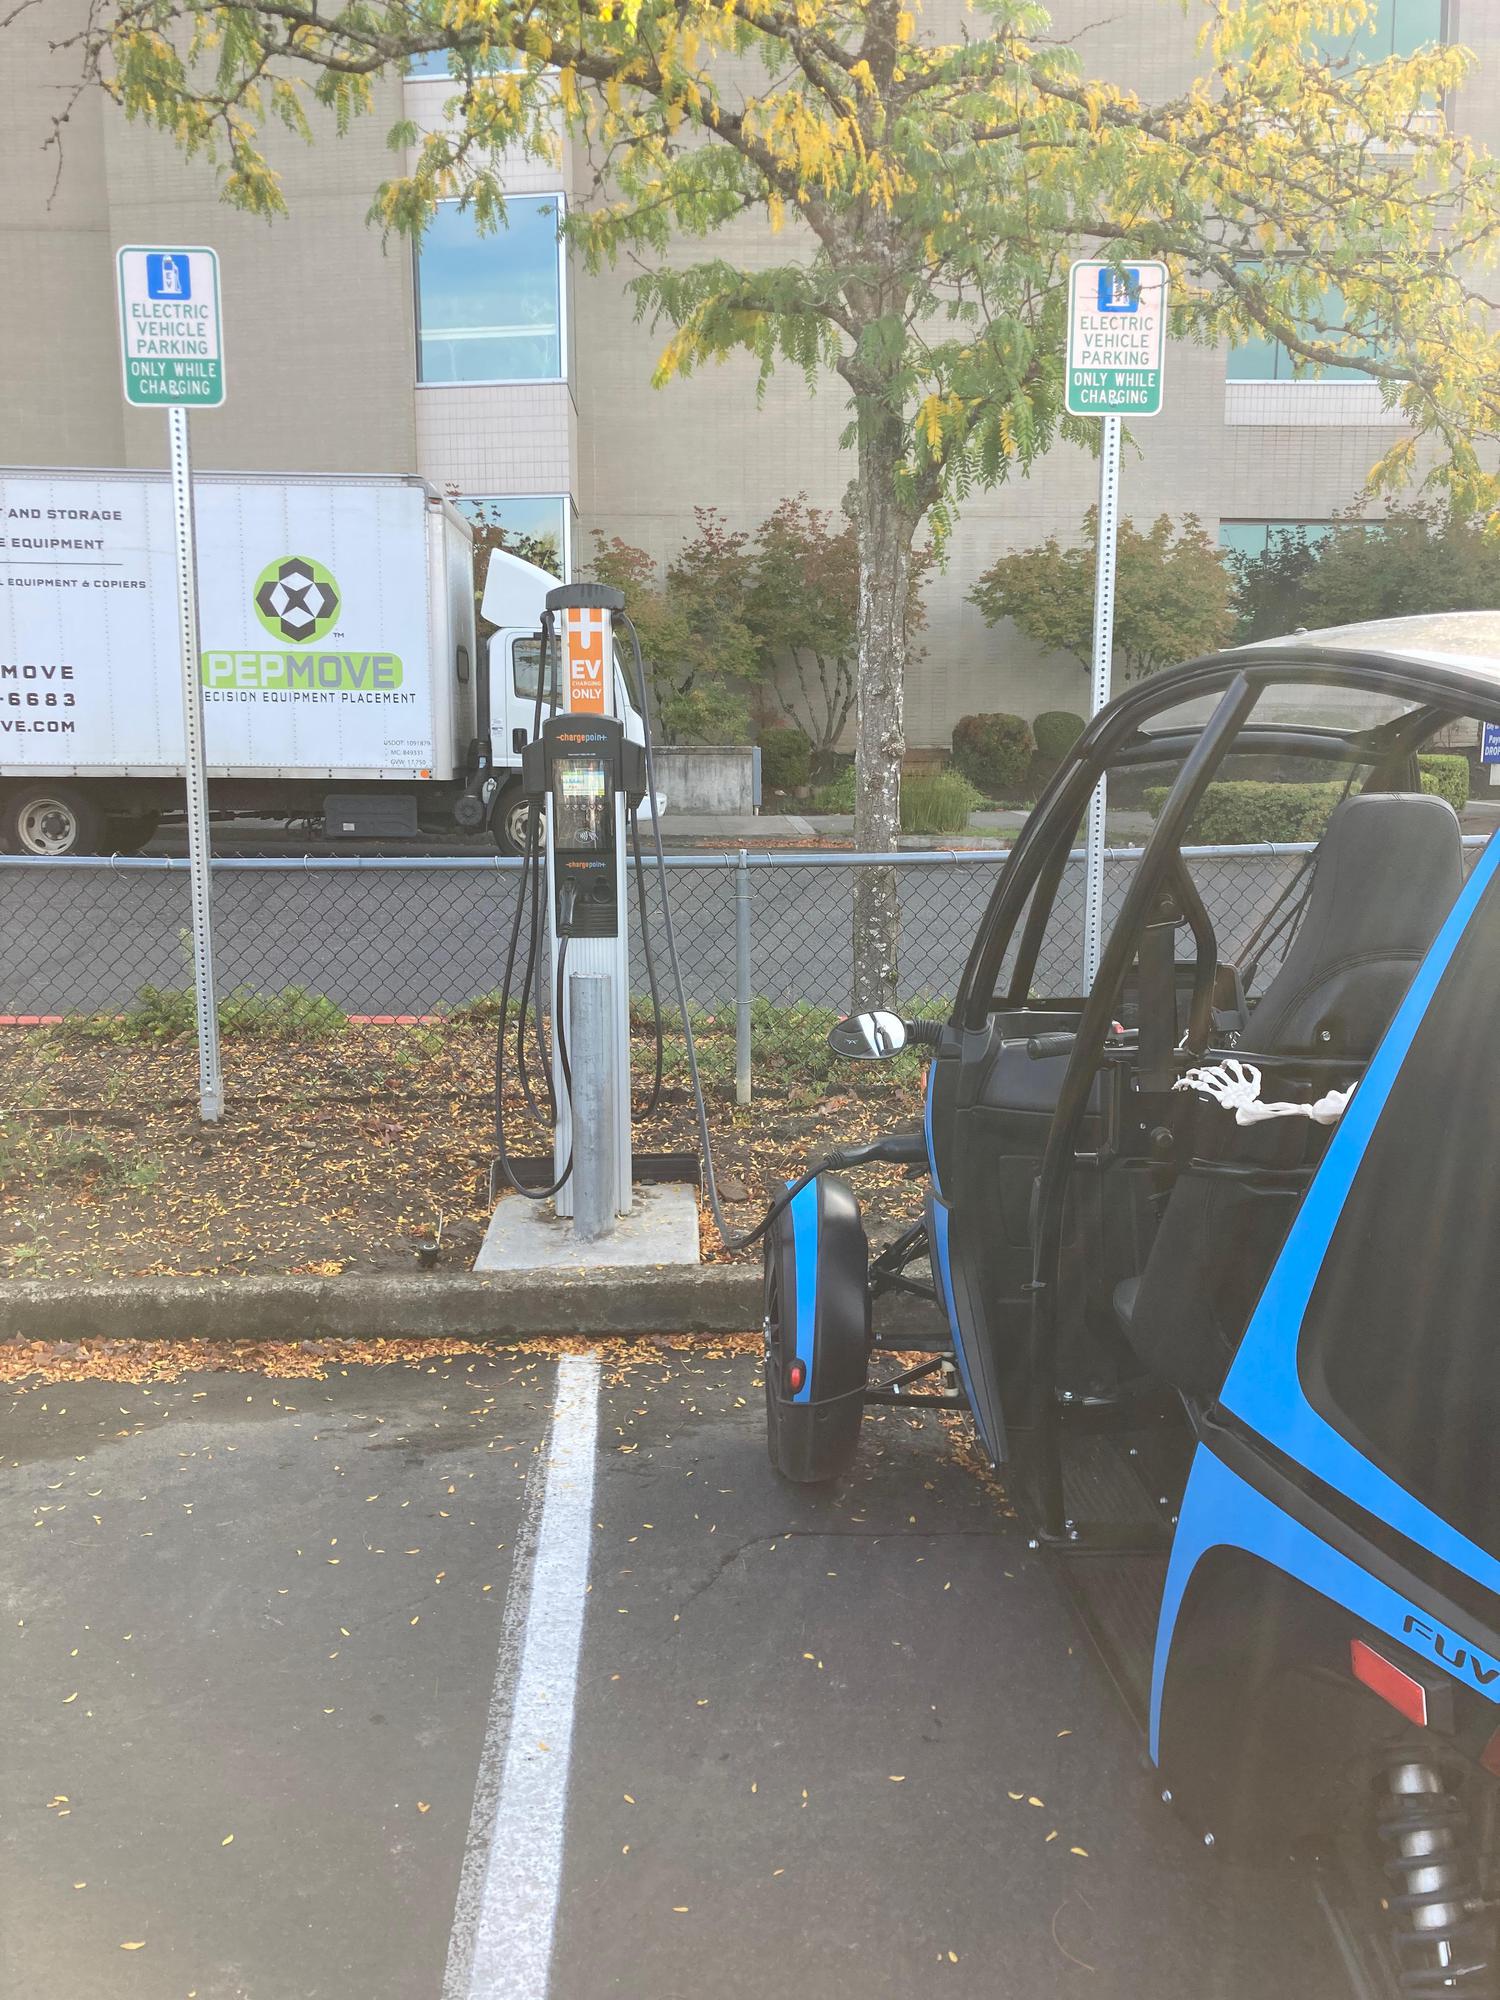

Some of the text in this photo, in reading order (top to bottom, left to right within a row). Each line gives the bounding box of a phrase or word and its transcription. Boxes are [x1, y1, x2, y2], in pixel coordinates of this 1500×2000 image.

[132, 303, 209, 319] ELECTRIC
[137, 321, 207, 337] VEHICLE
[1080, 316, 1154, 331] ELECTRIC
[137, 339, 208, 355] PARKING
[1084, 333, 1149, 348] VEHICLE
[1082, 350, 1149, 366] PARKING
[131, 361, 217, 378] ONLY WHILE
[139, 379, 210, 395] CHARGING
[1074, 371, 1156, 387] ONLY WHILE
[1080, 389, 1148, 404] CHARGING
[8, 508, 41, 519] AND
[47, 509, 122, 521] STORAGE
[11, 538, 104, 549] EQUIPMENT
[8, 578, 78, 588] EQUIPMENT
[82, 580, 90, 588] &
[93, 580, 147, 589] COPIERS
[1, 665, 74, 680] MOVE
[208, 653, 395, 689] PEPMOVE
[572, 659, 601, 679] EV
[205, 691, 416, 704] ECISION EQUIPMENT PLACEMENT
[572, 688, 602, 700] ONLY
[1403, 1615, 1500, 1685] FUV
